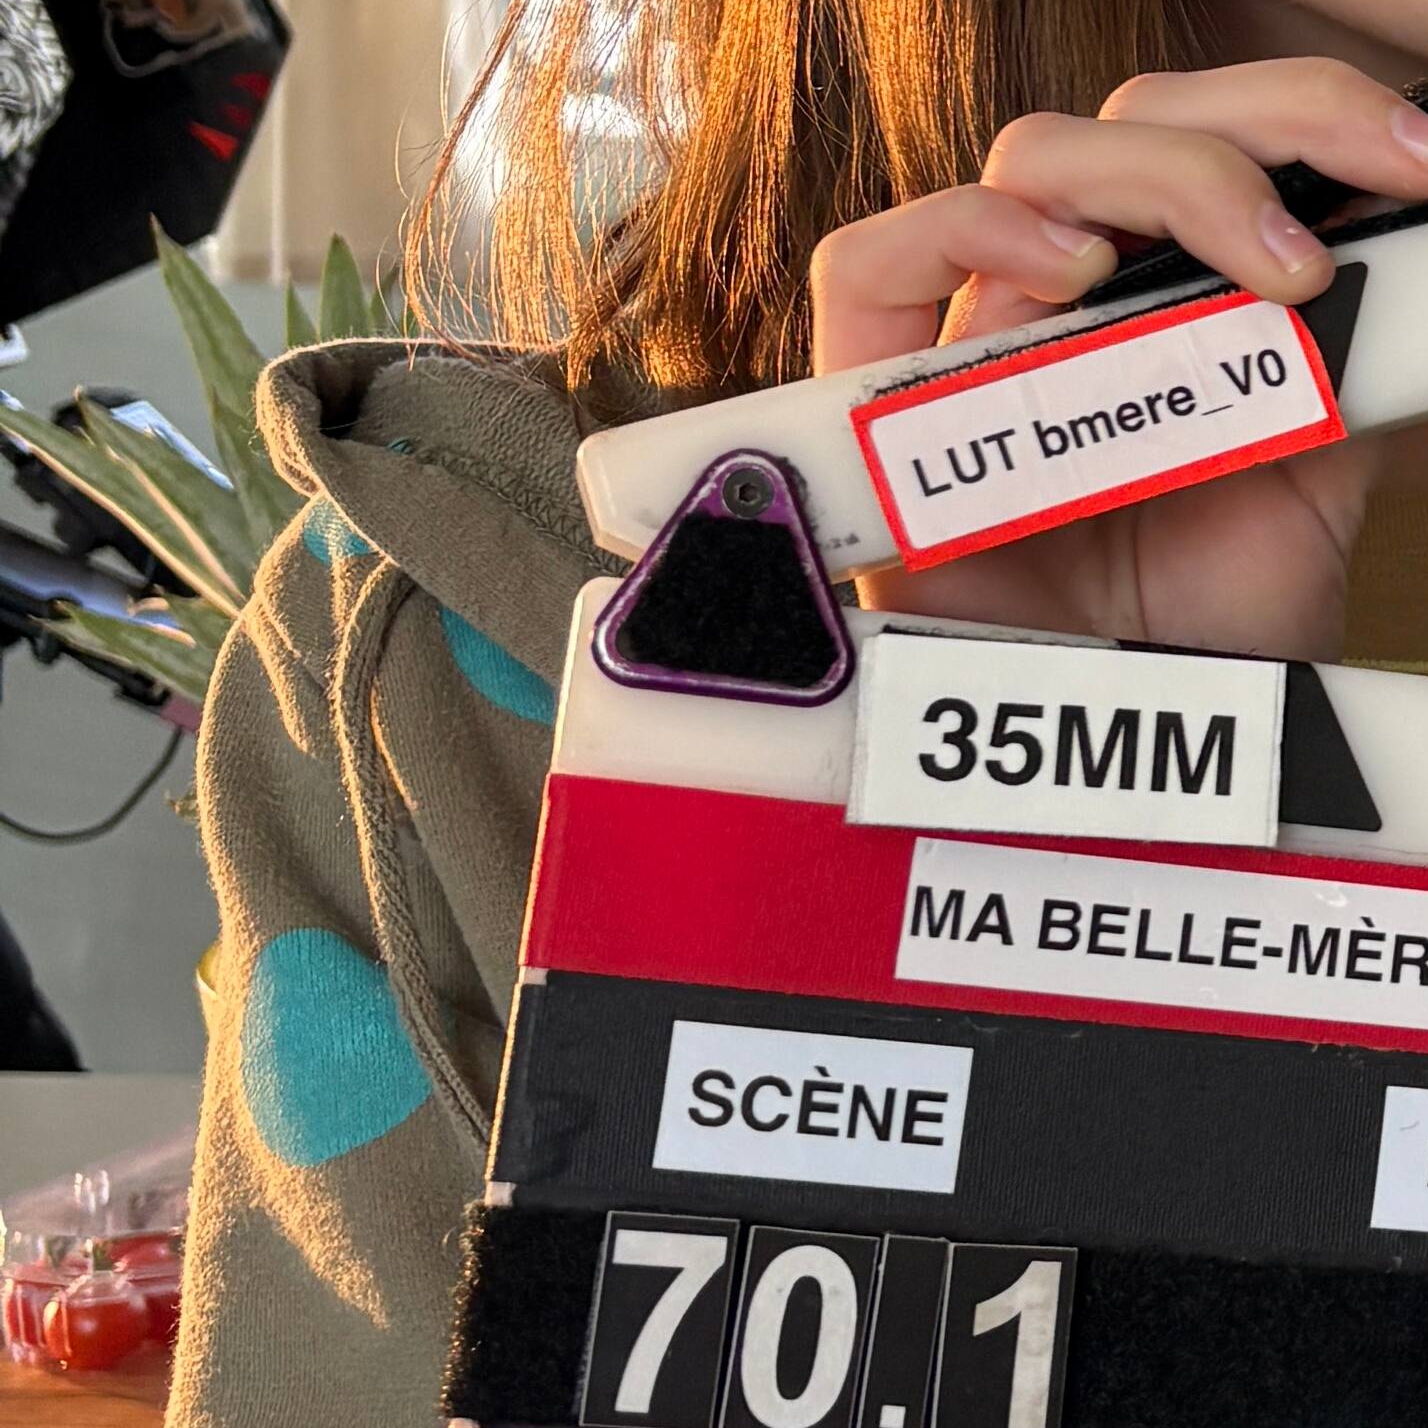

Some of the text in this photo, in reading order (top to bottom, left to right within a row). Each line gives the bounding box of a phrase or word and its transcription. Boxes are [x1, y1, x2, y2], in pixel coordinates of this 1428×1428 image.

[913, 348, 1288, 497] LUT bmere_V0
[919, 698, 1236, 796] 35MM
[909, 885, 1013, 946] MA
[689, 1066, 948, 1146] SCÈNE
